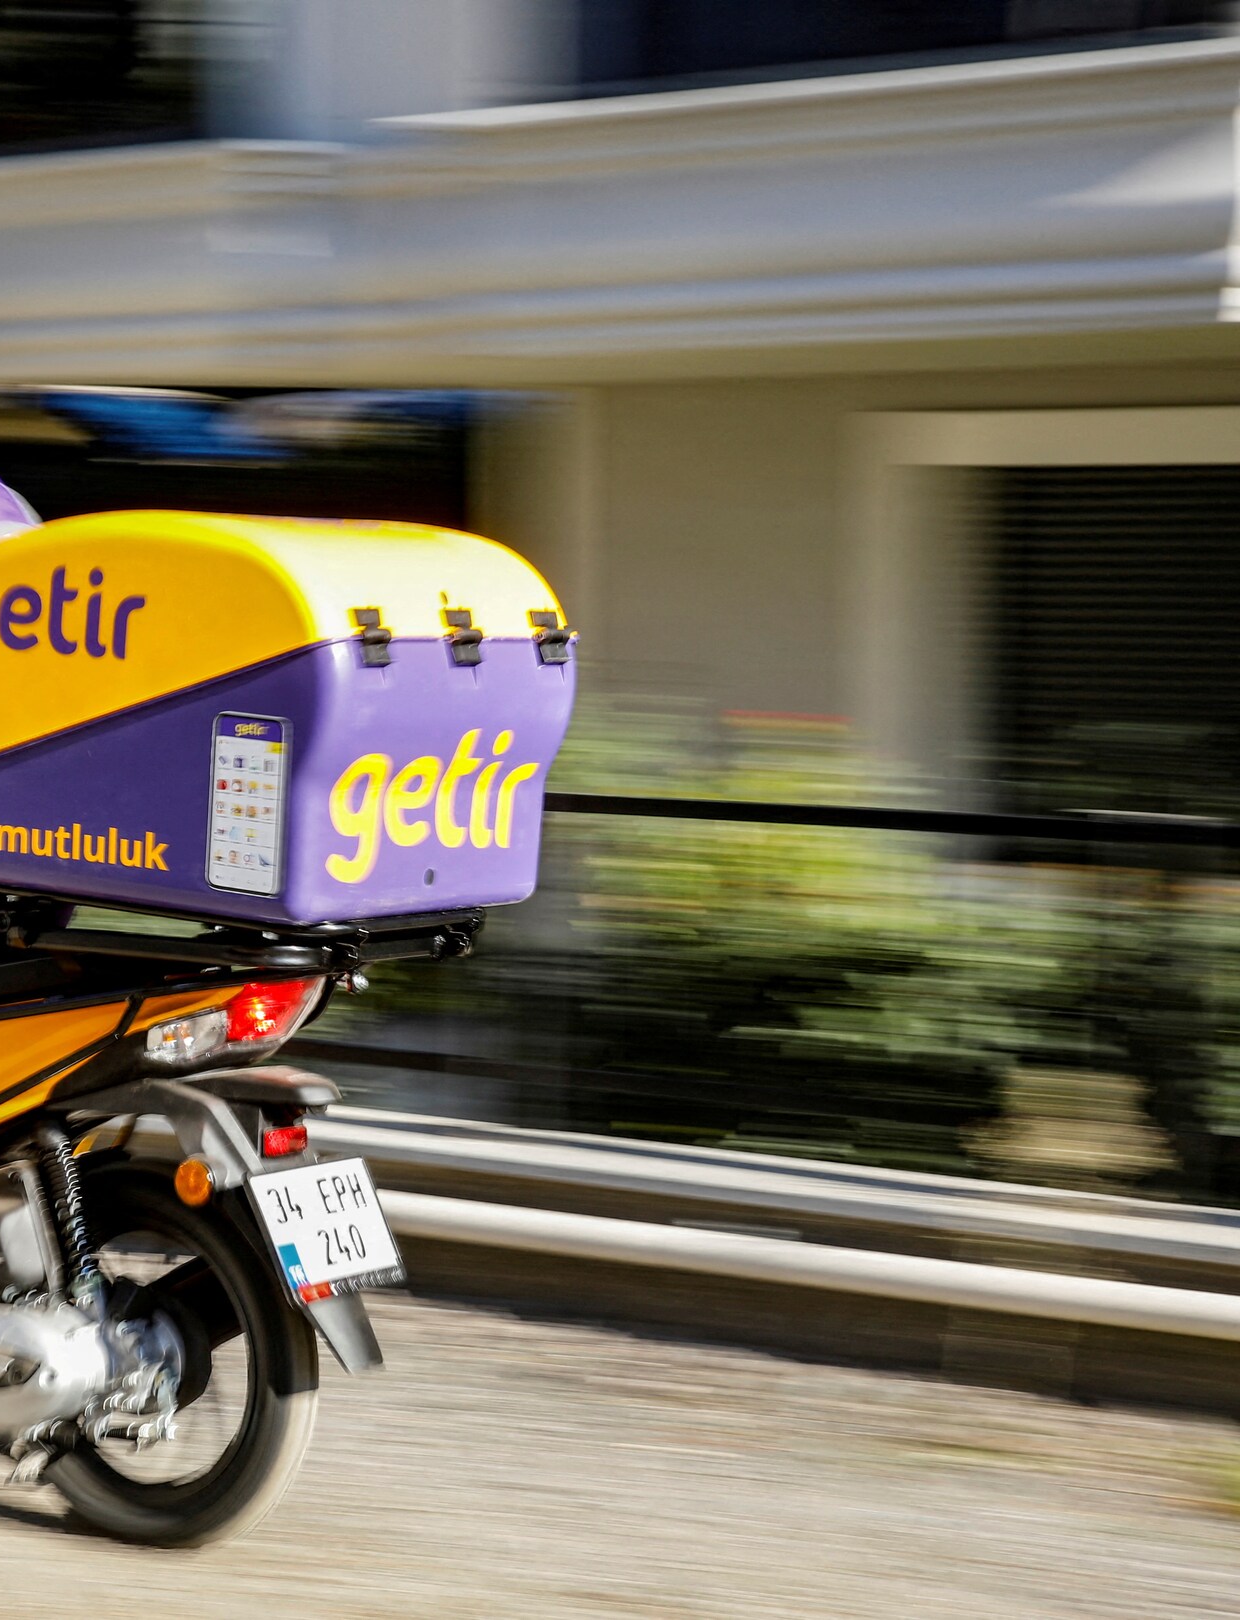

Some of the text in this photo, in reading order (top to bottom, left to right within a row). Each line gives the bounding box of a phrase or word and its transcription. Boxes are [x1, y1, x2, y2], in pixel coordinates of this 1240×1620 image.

[325, 728, 540, 884] getir
[267, 1173, 367, 1224] 34 EPH
[317, 1223, 367, 1266] 240
